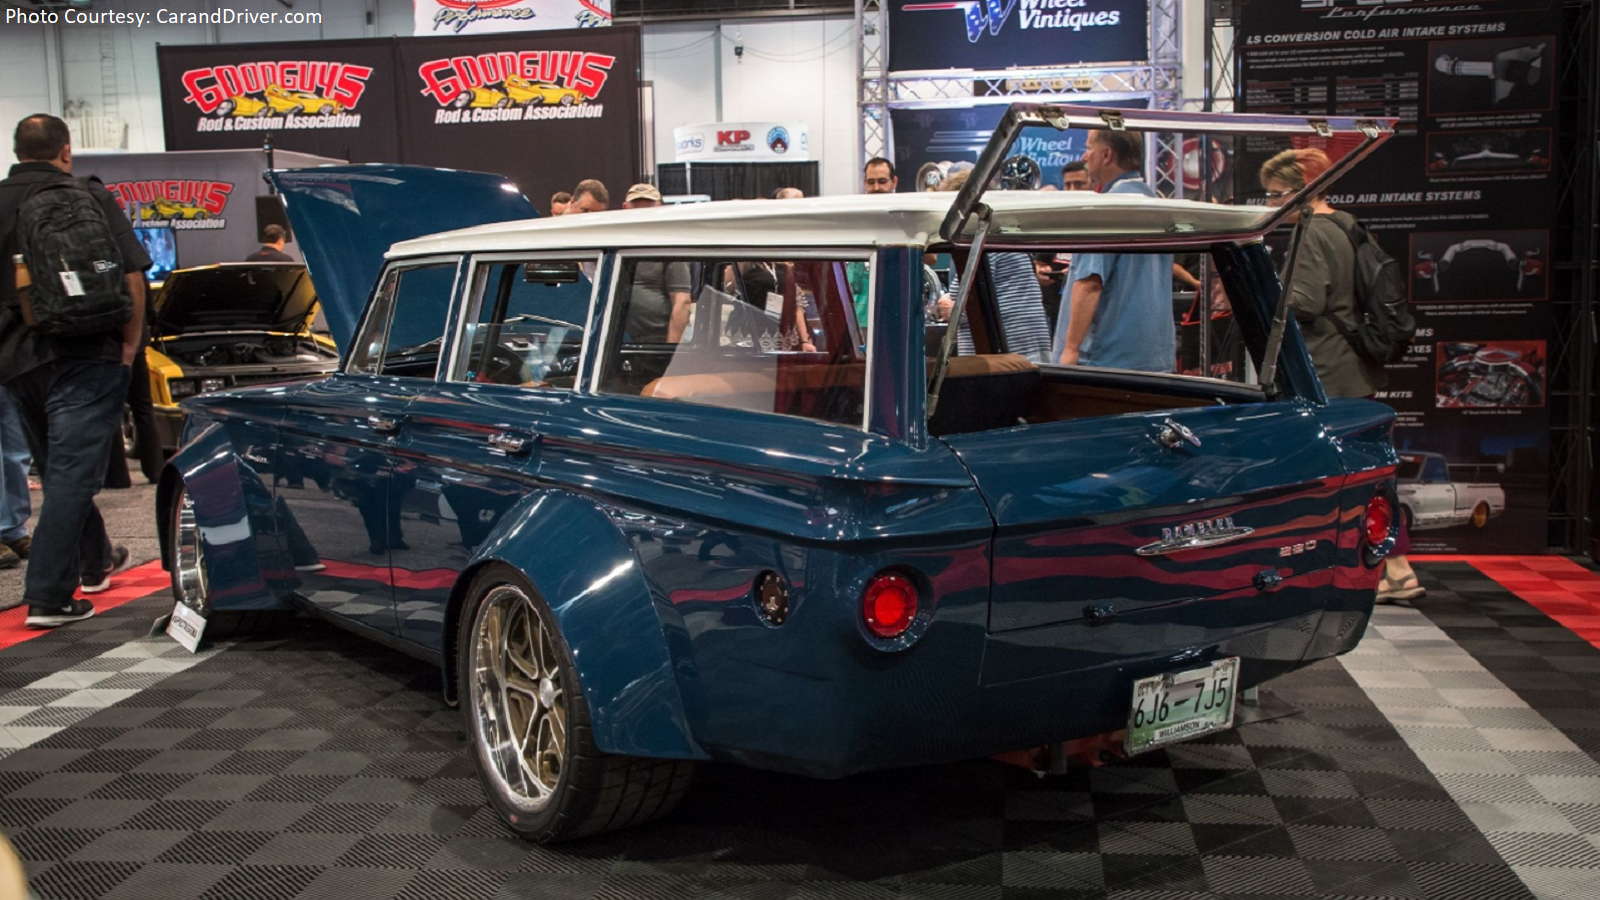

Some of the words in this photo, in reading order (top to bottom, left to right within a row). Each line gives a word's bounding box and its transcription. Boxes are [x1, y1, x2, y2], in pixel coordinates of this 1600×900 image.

[432, 5, 536, 33] Performance
[1019, 9, 1120, 31] Vintiques
[1246, 35, 1262, 45] LS
[1264, 31, 1342, 44] CONVERSION
[1343, 29, 1376, 40] COLD
[1378, 28, 1400, 38] AIR
[1402, 26, 1446, 37] INTAKE
[1447, 22, 1507, 35] SYSTEMS
[197, 117, 223, 132] Rod
[224, 119, 234, 131] &
[234, 115, 284, 130] Custom
[285, 112, 361, 129] Association
[434, 109, 461, 124] Rod
[461, 110, 471, 122] &
[472, 106, 523, 121] Custom
[524, 104, 603, 120] Association
[716, 130, 751, 146] KP
[1020, 136, 1073, 152] Wheel
[1325, 195, 1355, 205] COLD
[1357, 193, 1378, 203] AIR
[1380, 192, 1422, 203] INTAKE
[1425, 190, 1482, 201] SYSTEMS
[1389, 391, 1413, 399] KITS
[1159, 719, 1201, 738] WILLIAMSON
